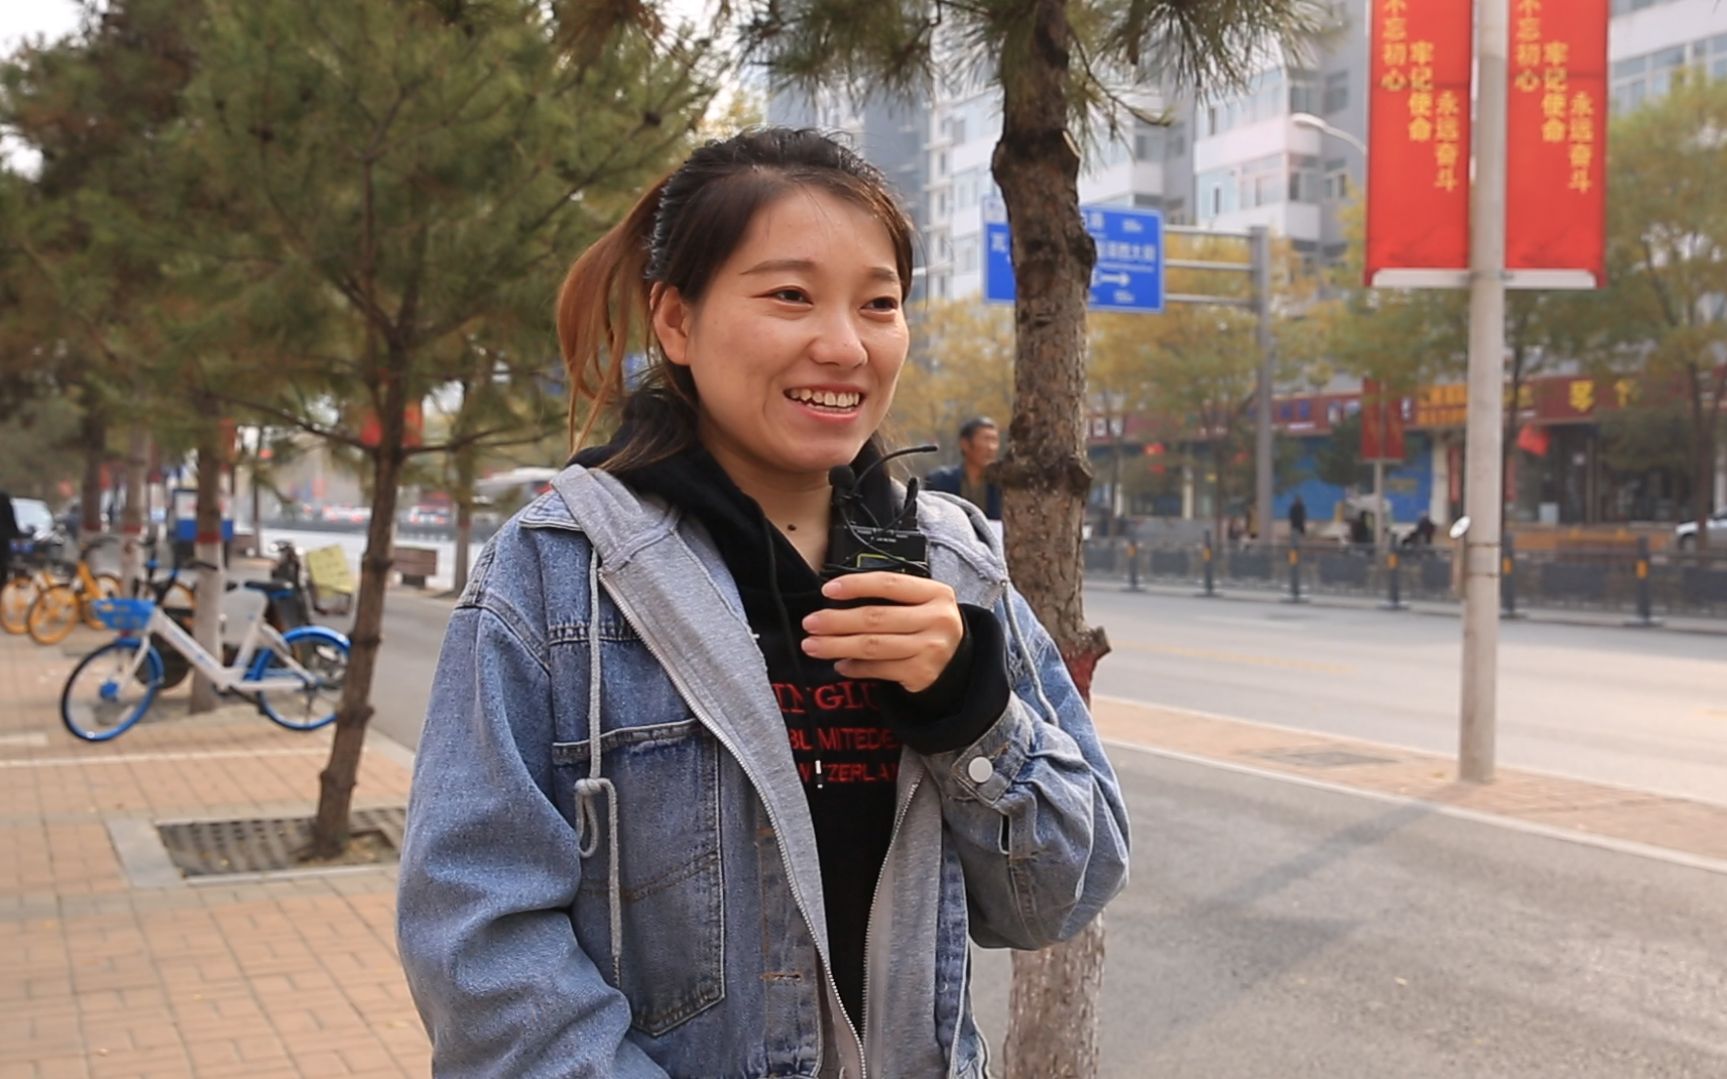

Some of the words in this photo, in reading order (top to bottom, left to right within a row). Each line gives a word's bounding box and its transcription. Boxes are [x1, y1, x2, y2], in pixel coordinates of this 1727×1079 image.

[1408, 41, 1434, 142] 牢记使命
[1434, 90, 1459, 192] 永远奋斗
[1542, 41, 1568, 142] 牢记使命
[1568, 91, 1594, 193] 永远奋斗
